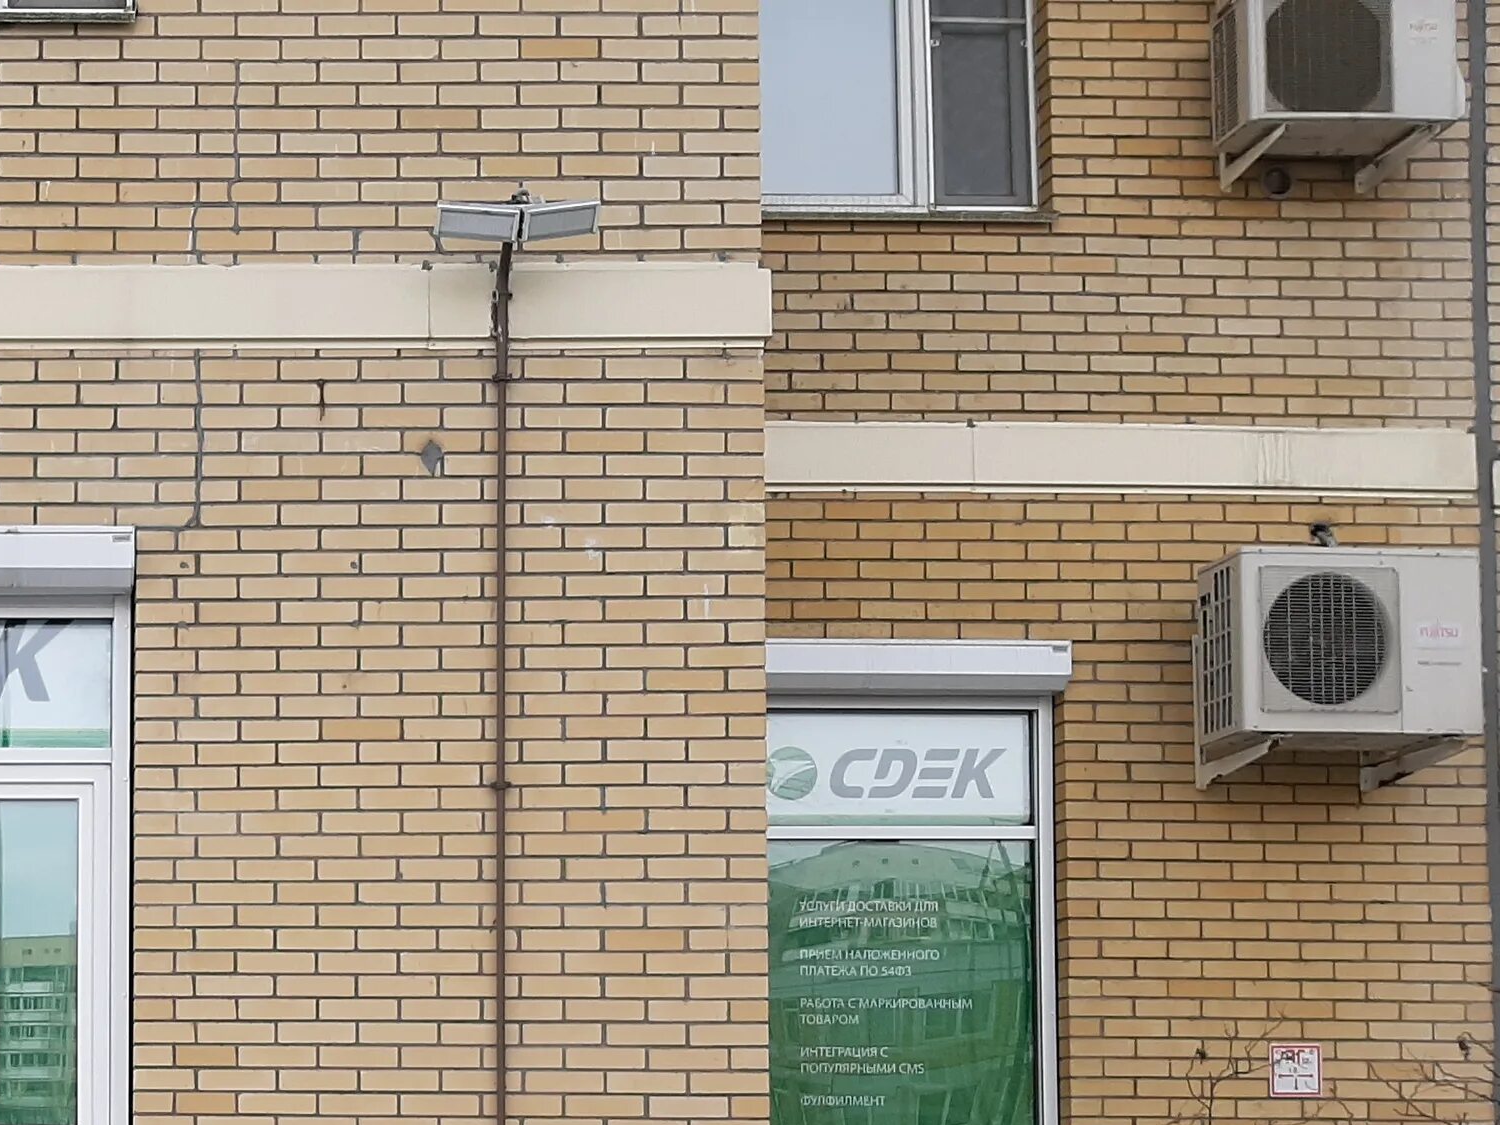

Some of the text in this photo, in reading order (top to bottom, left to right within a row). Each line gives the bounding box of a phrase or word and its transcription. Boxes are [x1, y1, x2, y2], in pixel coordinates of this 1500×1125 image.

[829, 748, 1007, 799] CDEK
[799, 901, 939, 913] УСЛУГИ ДОСТАВКИ ДЛЯ
[799, 917, 937, 928] ИНТЕРНЕТ-МАГАЗИНОВ
[845, 950, 940, 961] НАЛОЖЕННОГО
[800, 965, 856, 976] ПЛАТЕЖА
[860, 965, 878, 976] ПО
[800, 998, 973, 1009] РАБОТА С МАРКИРОВАННЫМ
[800, 1014, 860, 1025] ТОВАРОМ
[800, 1047, 889, 1058] ИНТЕГРАЦИЯ С
[800, 1063, 925, 1074] ПОПУЛЯРНЫМИ CMS
[800, 1095, 886, 1107] ФУЛФИЛМЕНТ
